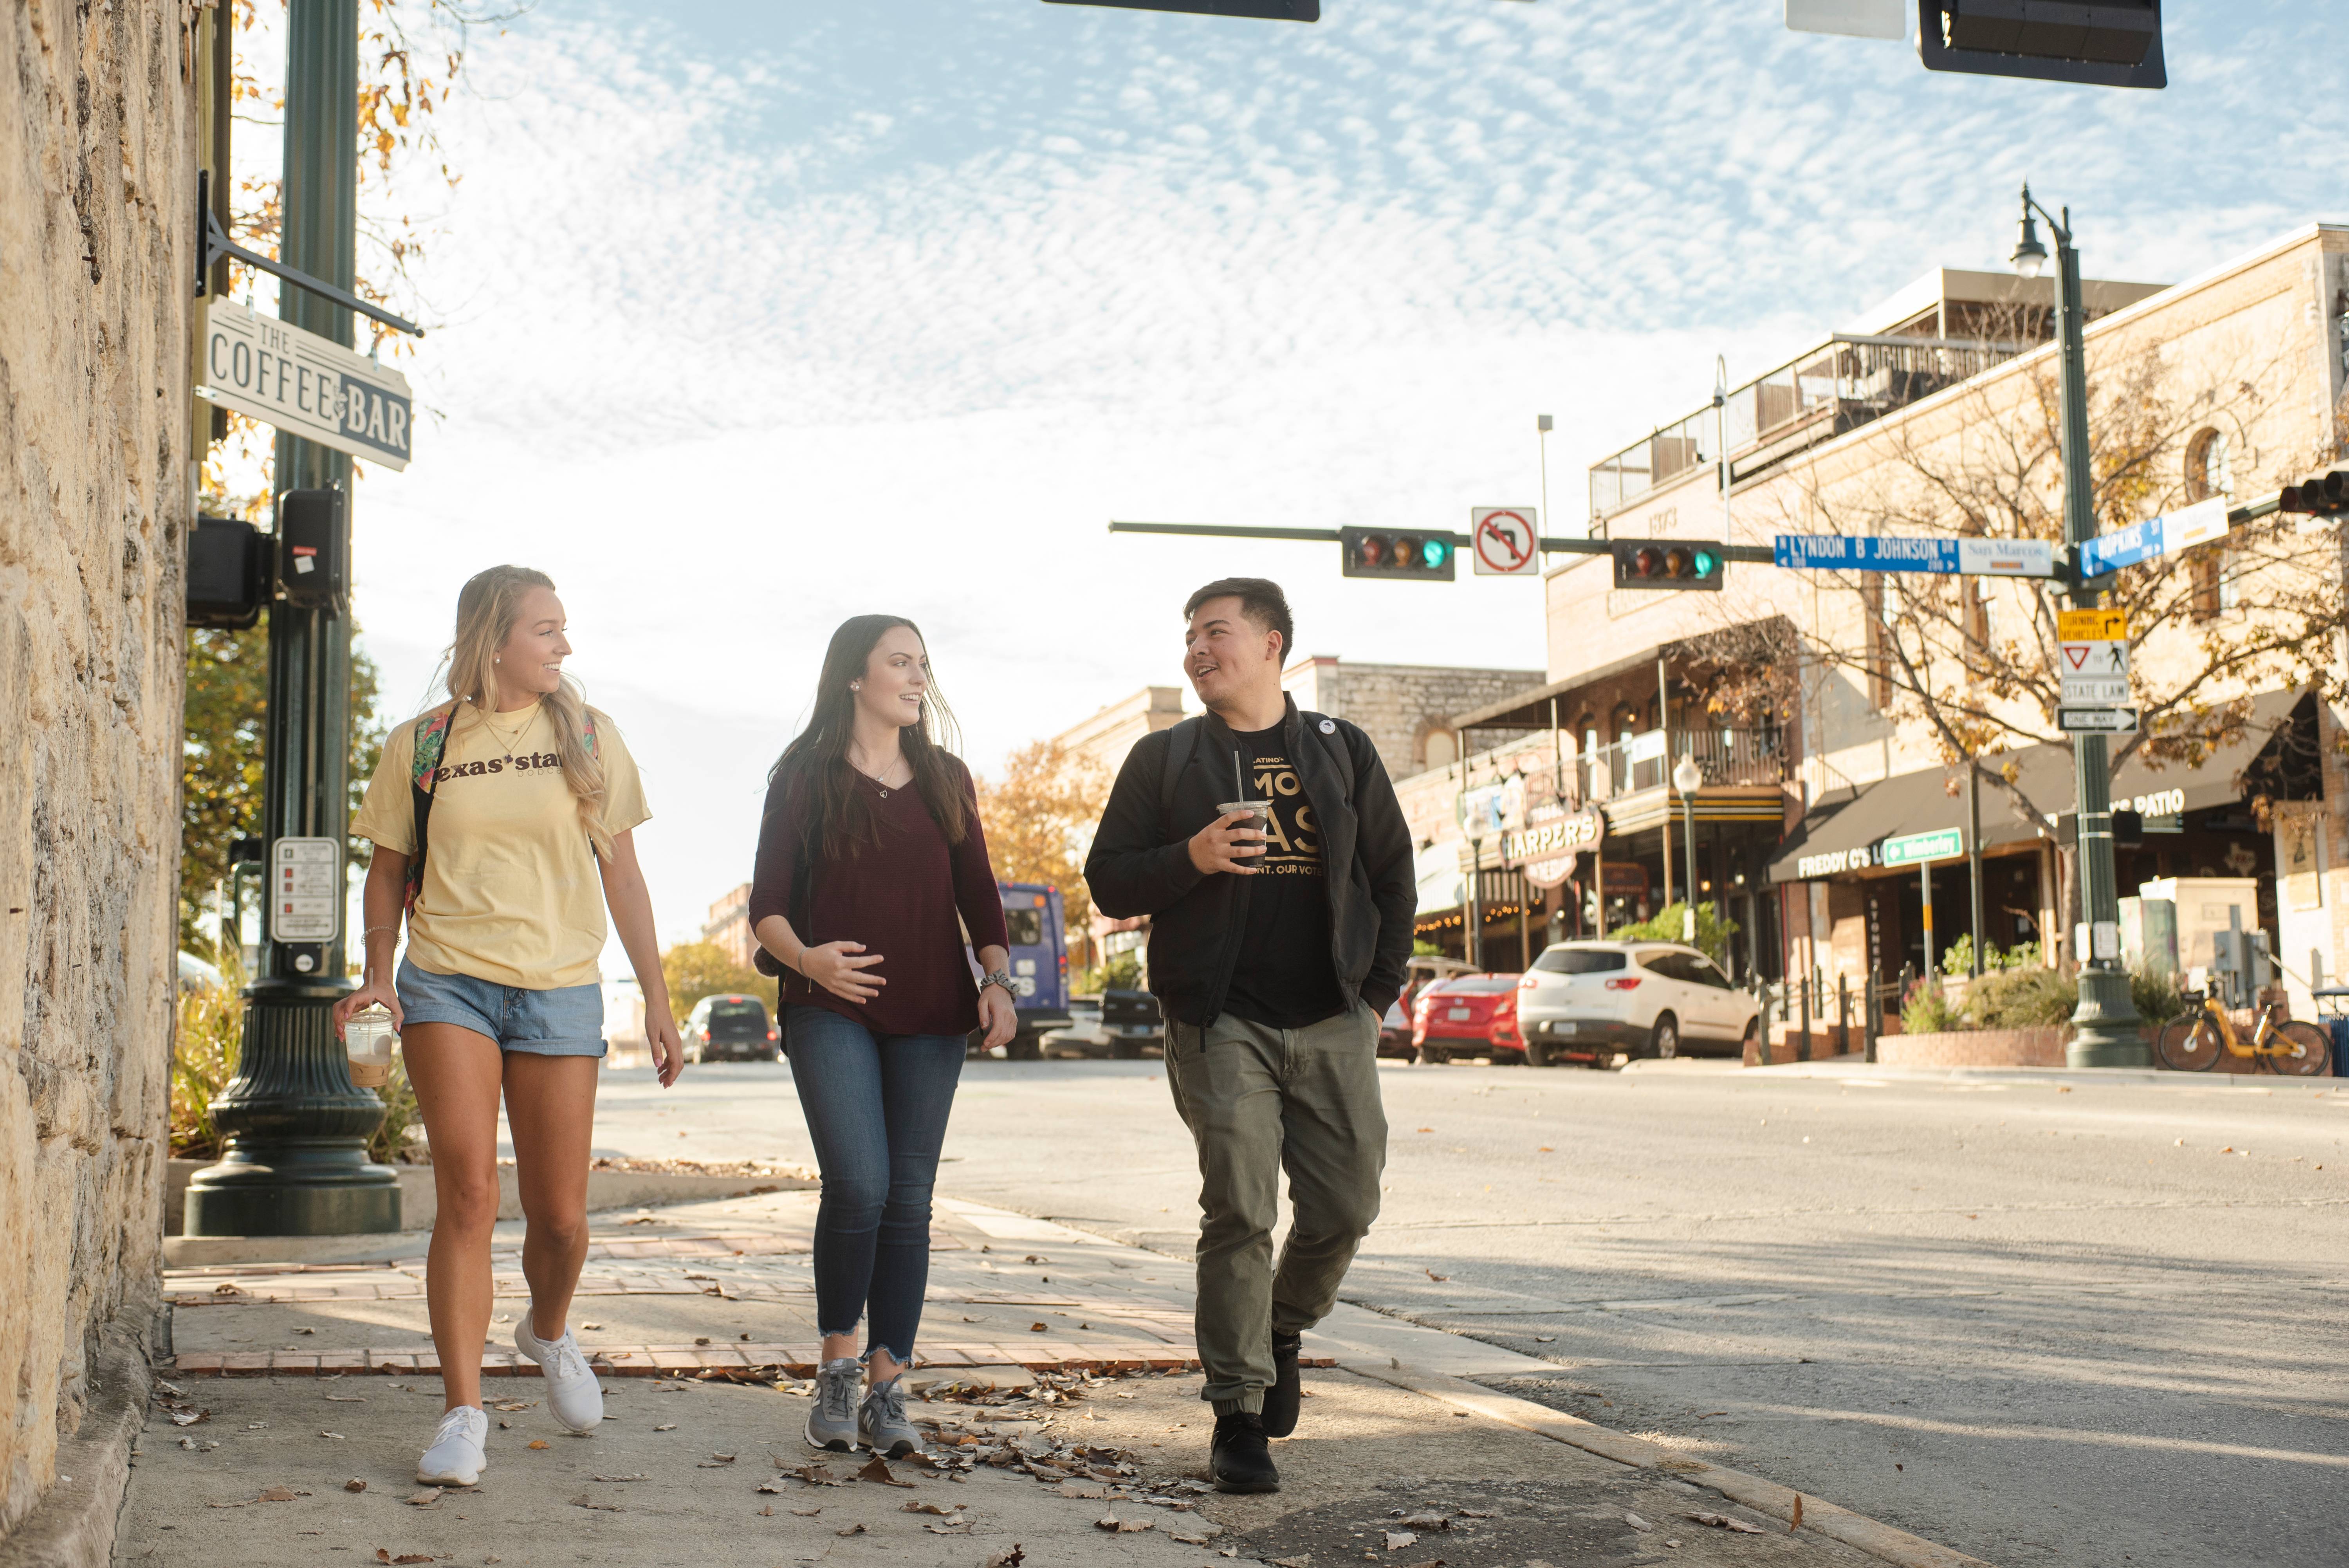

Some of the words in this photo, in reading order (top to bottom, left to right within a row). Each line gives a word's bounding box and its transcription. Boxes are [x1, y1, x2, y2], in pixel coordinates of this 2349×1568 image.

[260, 323, 290, 354] THE
[211, 333, 332, 421] COFFEE
[347, 383, 408, 451] BAR
[1779, 535, 1787, 550] N
[1790, 536, 1846, 558] LYNDON
[1855, 537, 1866, 559] B
[1873, 538, 1939, 561] JOHNSON
[1941, 540, 1955, 554] DR
[1968, 543, 1992, 557] San
[1996, 543, 2042, 558] Marcos
[2097, 525, 2143, 560] HOPKINS
[2151, 519, 2160, 536] ST
[2062, 615, 2099, 626] TURNING
[2061, 628, 2104, 640] VEHICLES
[2065, 682, 2096, 699] STATE
[2101, 682, 2126, 699] LAW
[2067, 713, 2088, 726] ONE
[2092, 713, 2114, 726] WAY
[437, 760, 503, 782] exas
[515, 752, 564, 770] sta
[518, 766, 563, 777] bobca
[1254, 772, 1302, 796] MO
[2134, 788, 2185, 819] PATIO
[1266, 799, 1320, 853] ÁS
[1503, 815, 1596, 860] HARPER'S
[1903, 835, 1955, 859] Wimberley
[1276, 864, 1297, 875] OUR
[1798, 850, 1848, 879] FREDDY
[1848, 846, 1872, 870] C'S
